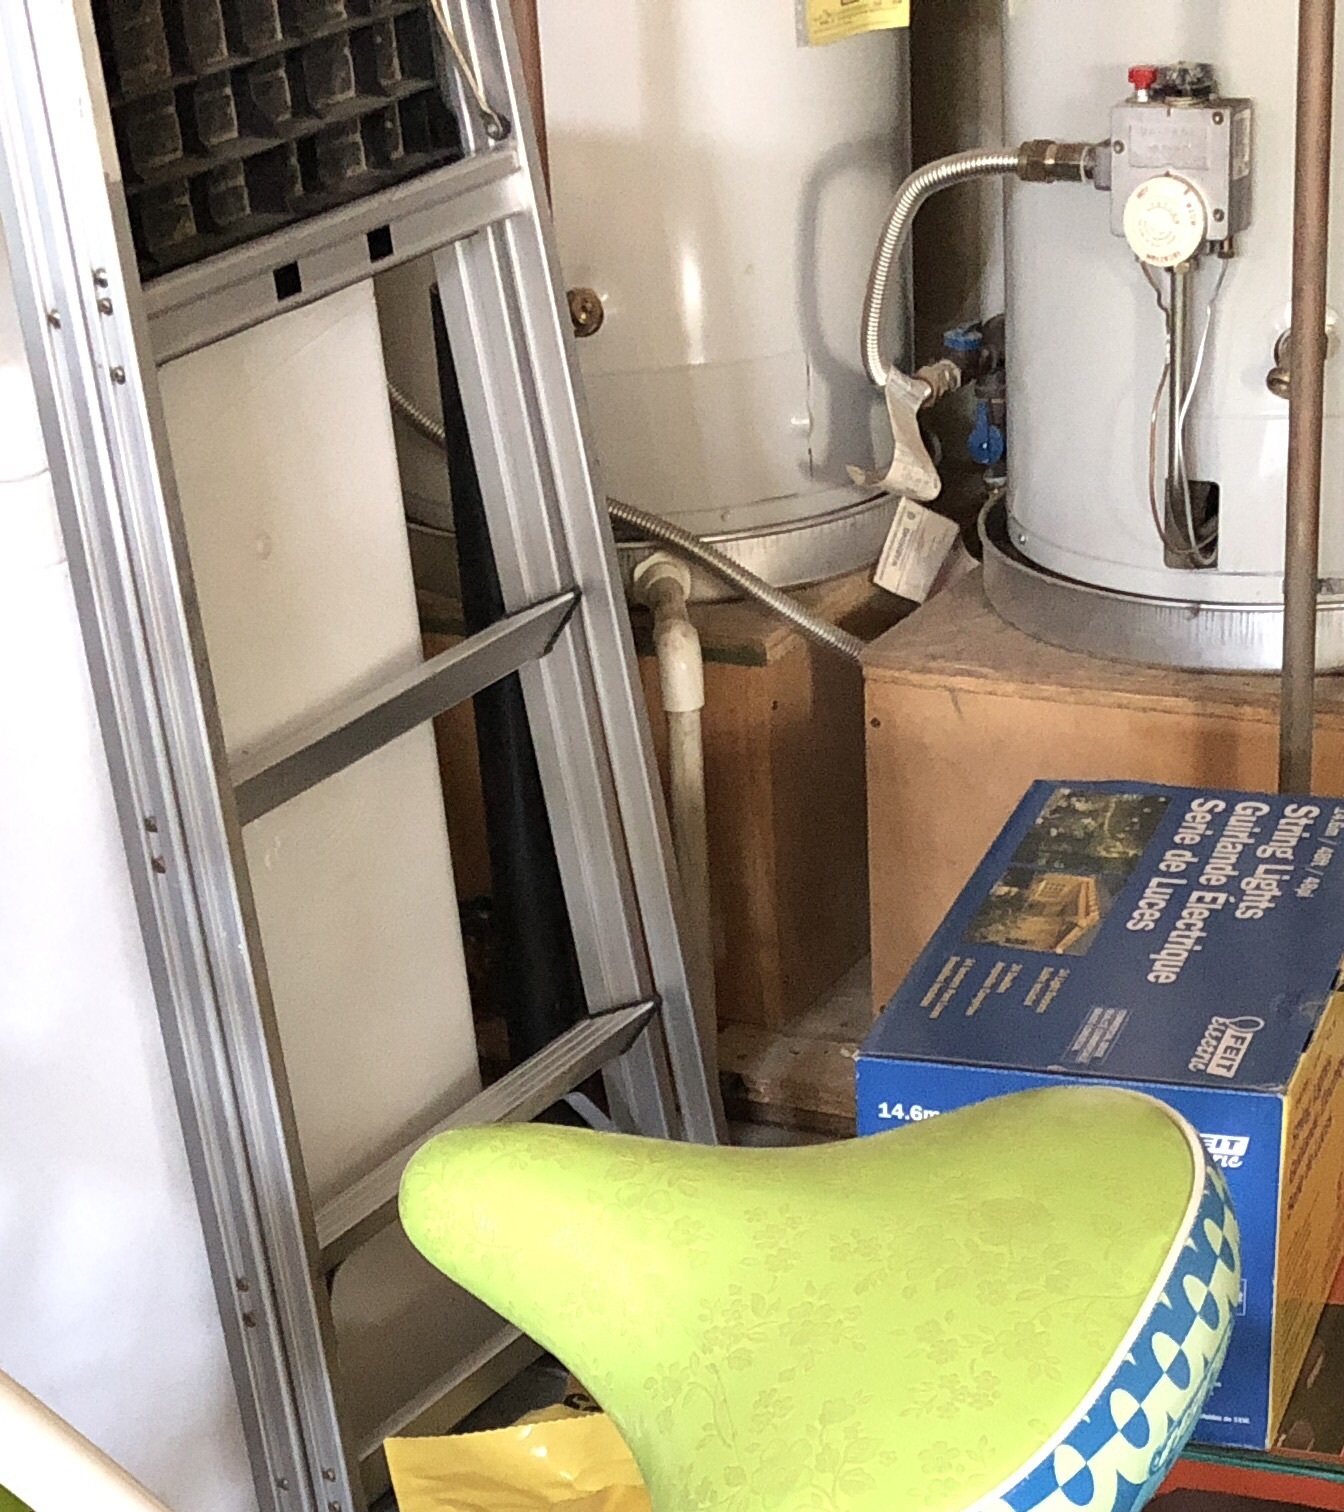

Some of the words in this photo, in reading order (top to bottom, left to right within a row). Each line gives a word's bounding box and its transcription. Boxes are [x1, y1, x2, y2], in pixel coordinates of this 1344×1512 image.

[1174, 799, 1226, 844] Serie
[1199, 802, 1270, 885] Guirlande
[1256, 804, 1320, 859] String
[1159, 850, 1198, 872] de
[1127, 878, 1187, 930] Luces
[1230, 864, 1294, 918] Lights
[1147, 891, 1235, 983] Électrique
[1216, 1035, 1247, 1072] FEIT
